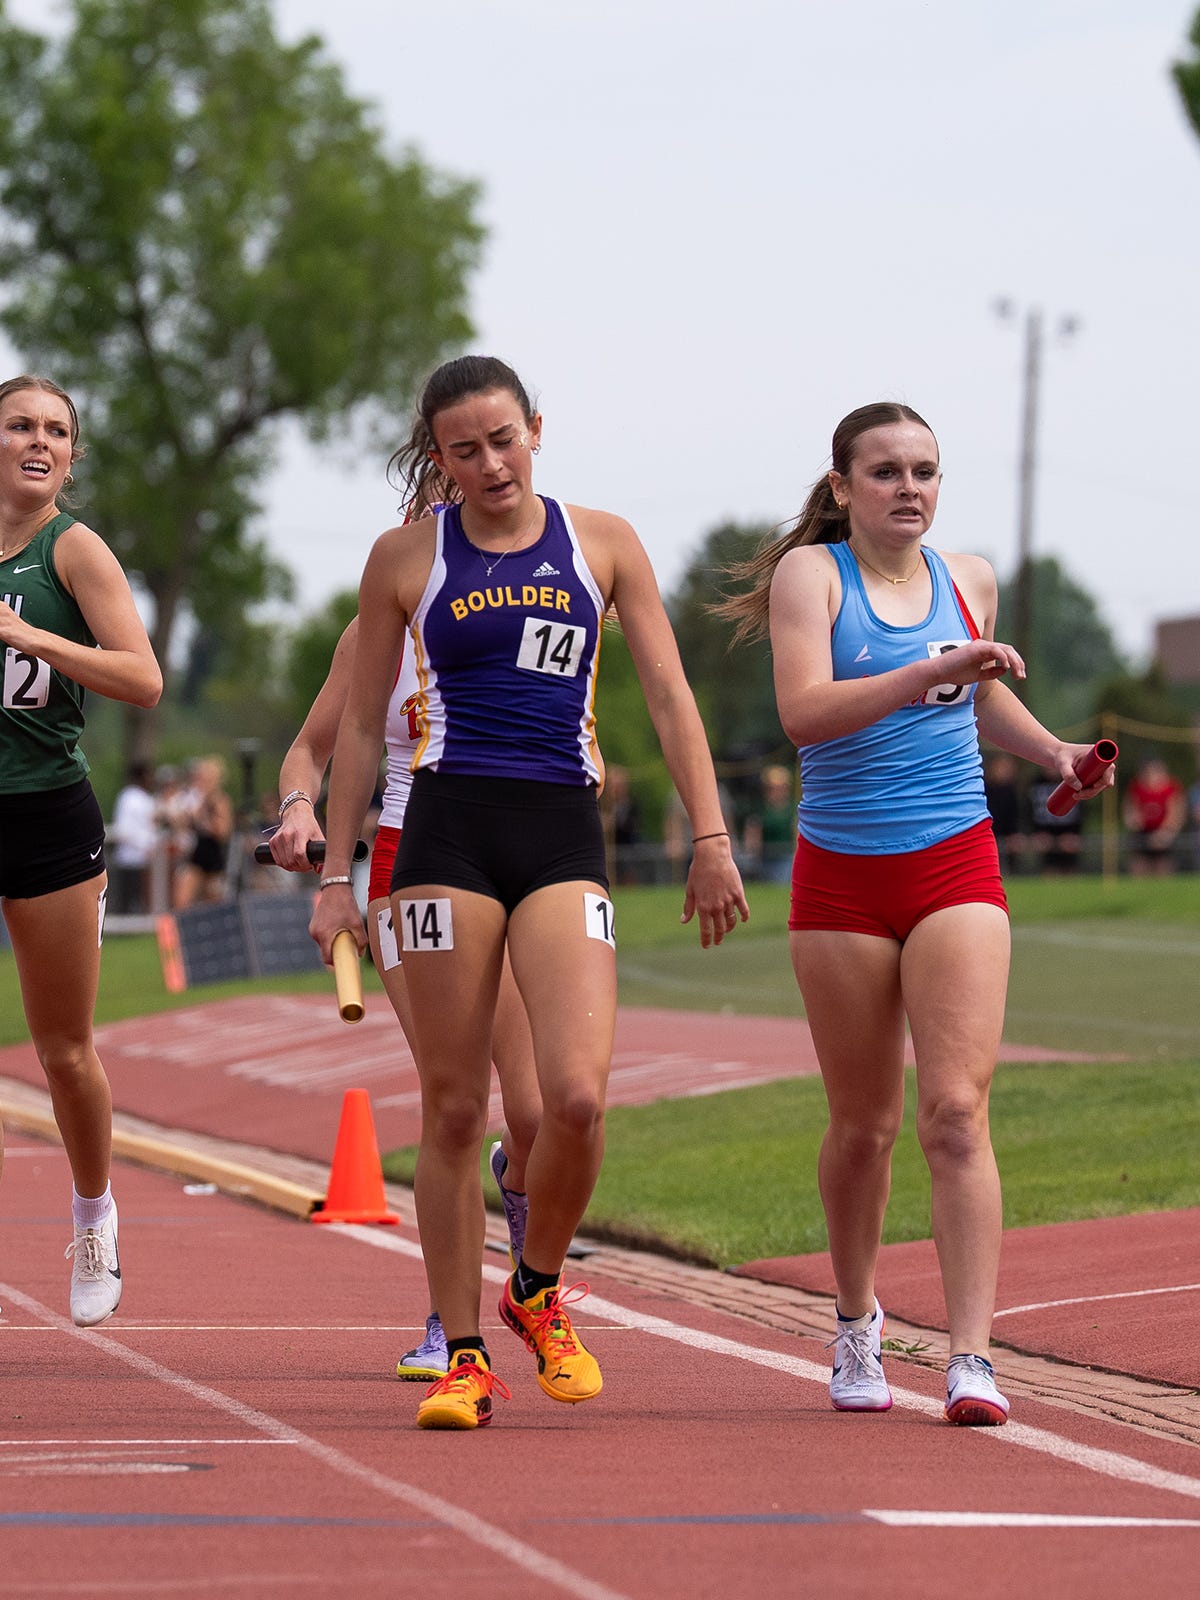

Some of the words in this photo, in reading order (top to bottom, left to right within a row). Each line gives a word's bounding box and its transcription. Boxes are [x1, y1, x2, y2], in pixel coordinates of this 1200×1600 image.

[532, 569, 560, 577] adidas
[450, 586, 571, 621] BOULDER
[535, 625, 575, 672] 14
[11, 652, 39, 705] 2
[406, 903, 442, 948] 14
[596, 901, 616, 941] 1
